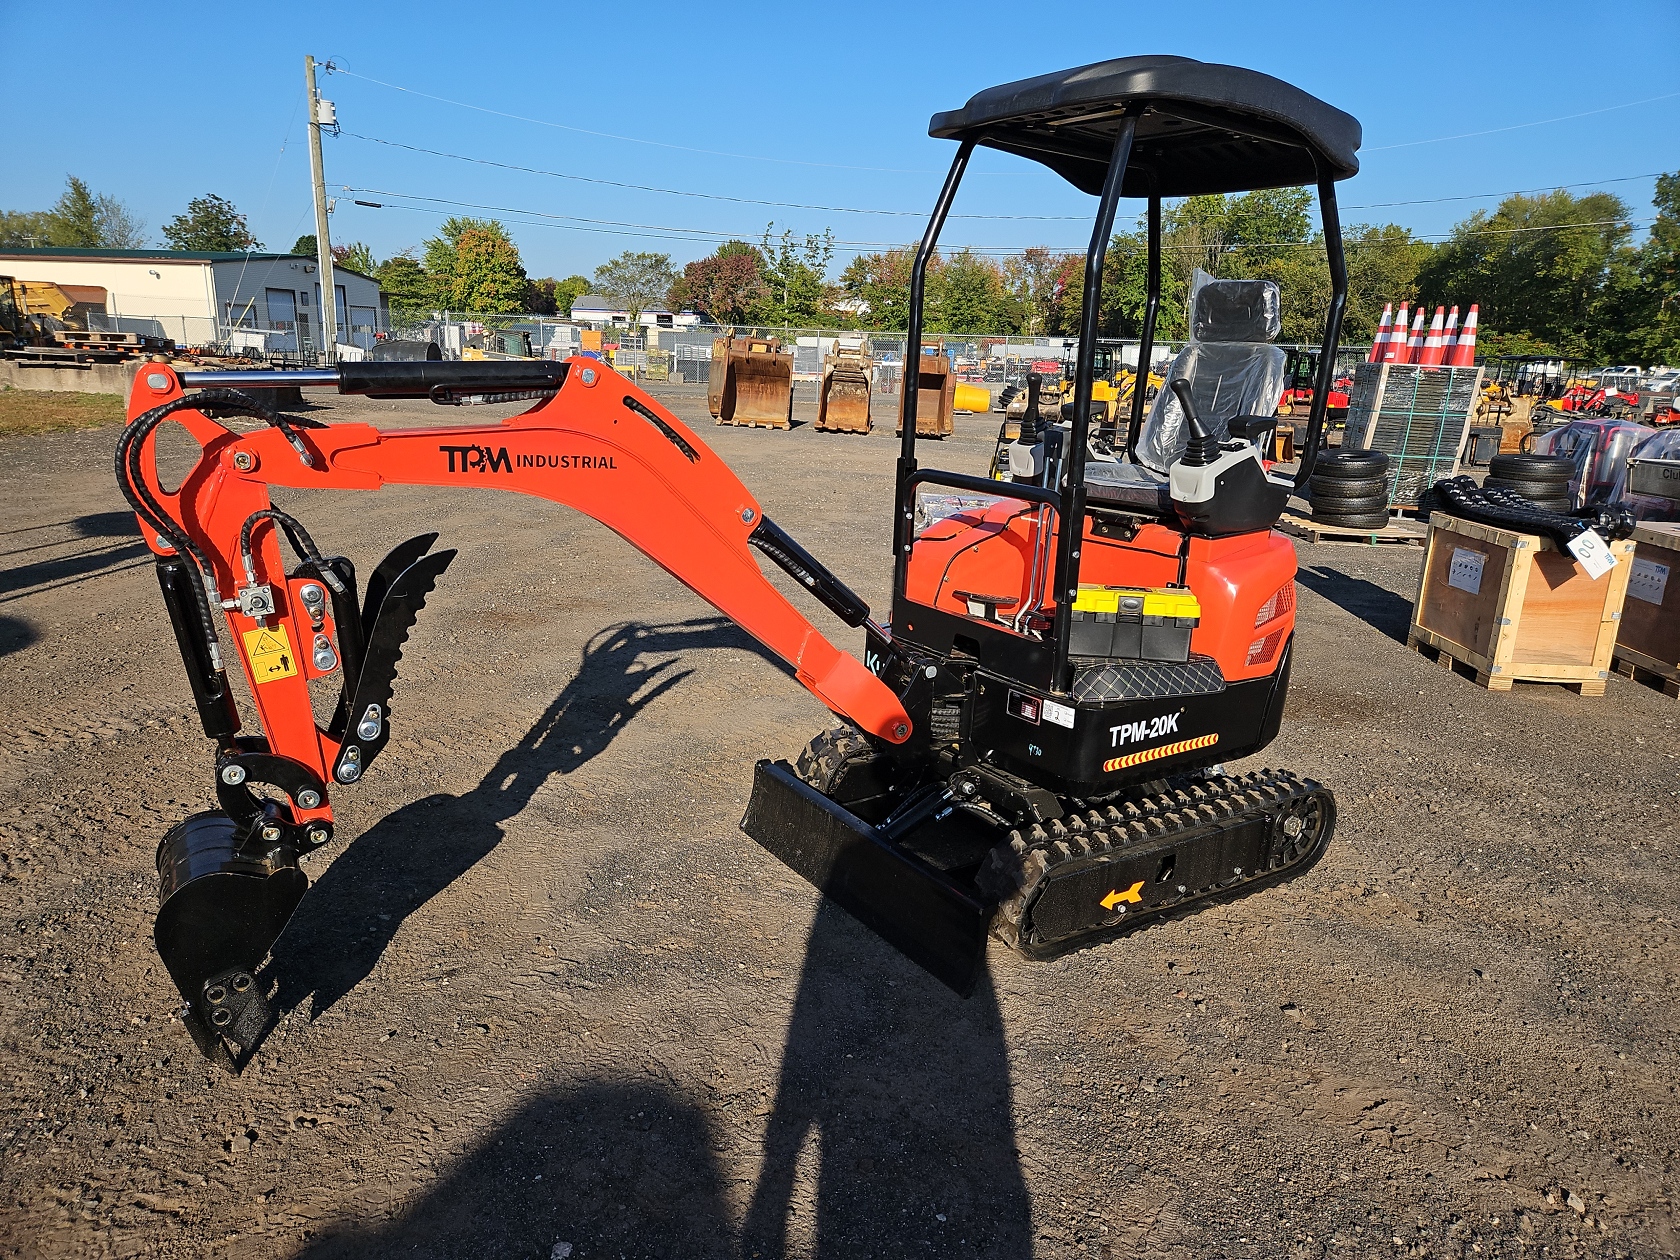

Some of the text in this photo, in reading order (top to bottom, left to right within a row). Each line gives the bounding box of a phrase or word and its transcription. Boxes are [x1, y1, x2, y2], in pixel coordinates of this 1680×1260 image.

[439, 444, 618, 473] TPM INDUSTRIAL
[1662, 468, 1680, 480] Clu
[1109, 712, 1181, 747] TPM-20K
